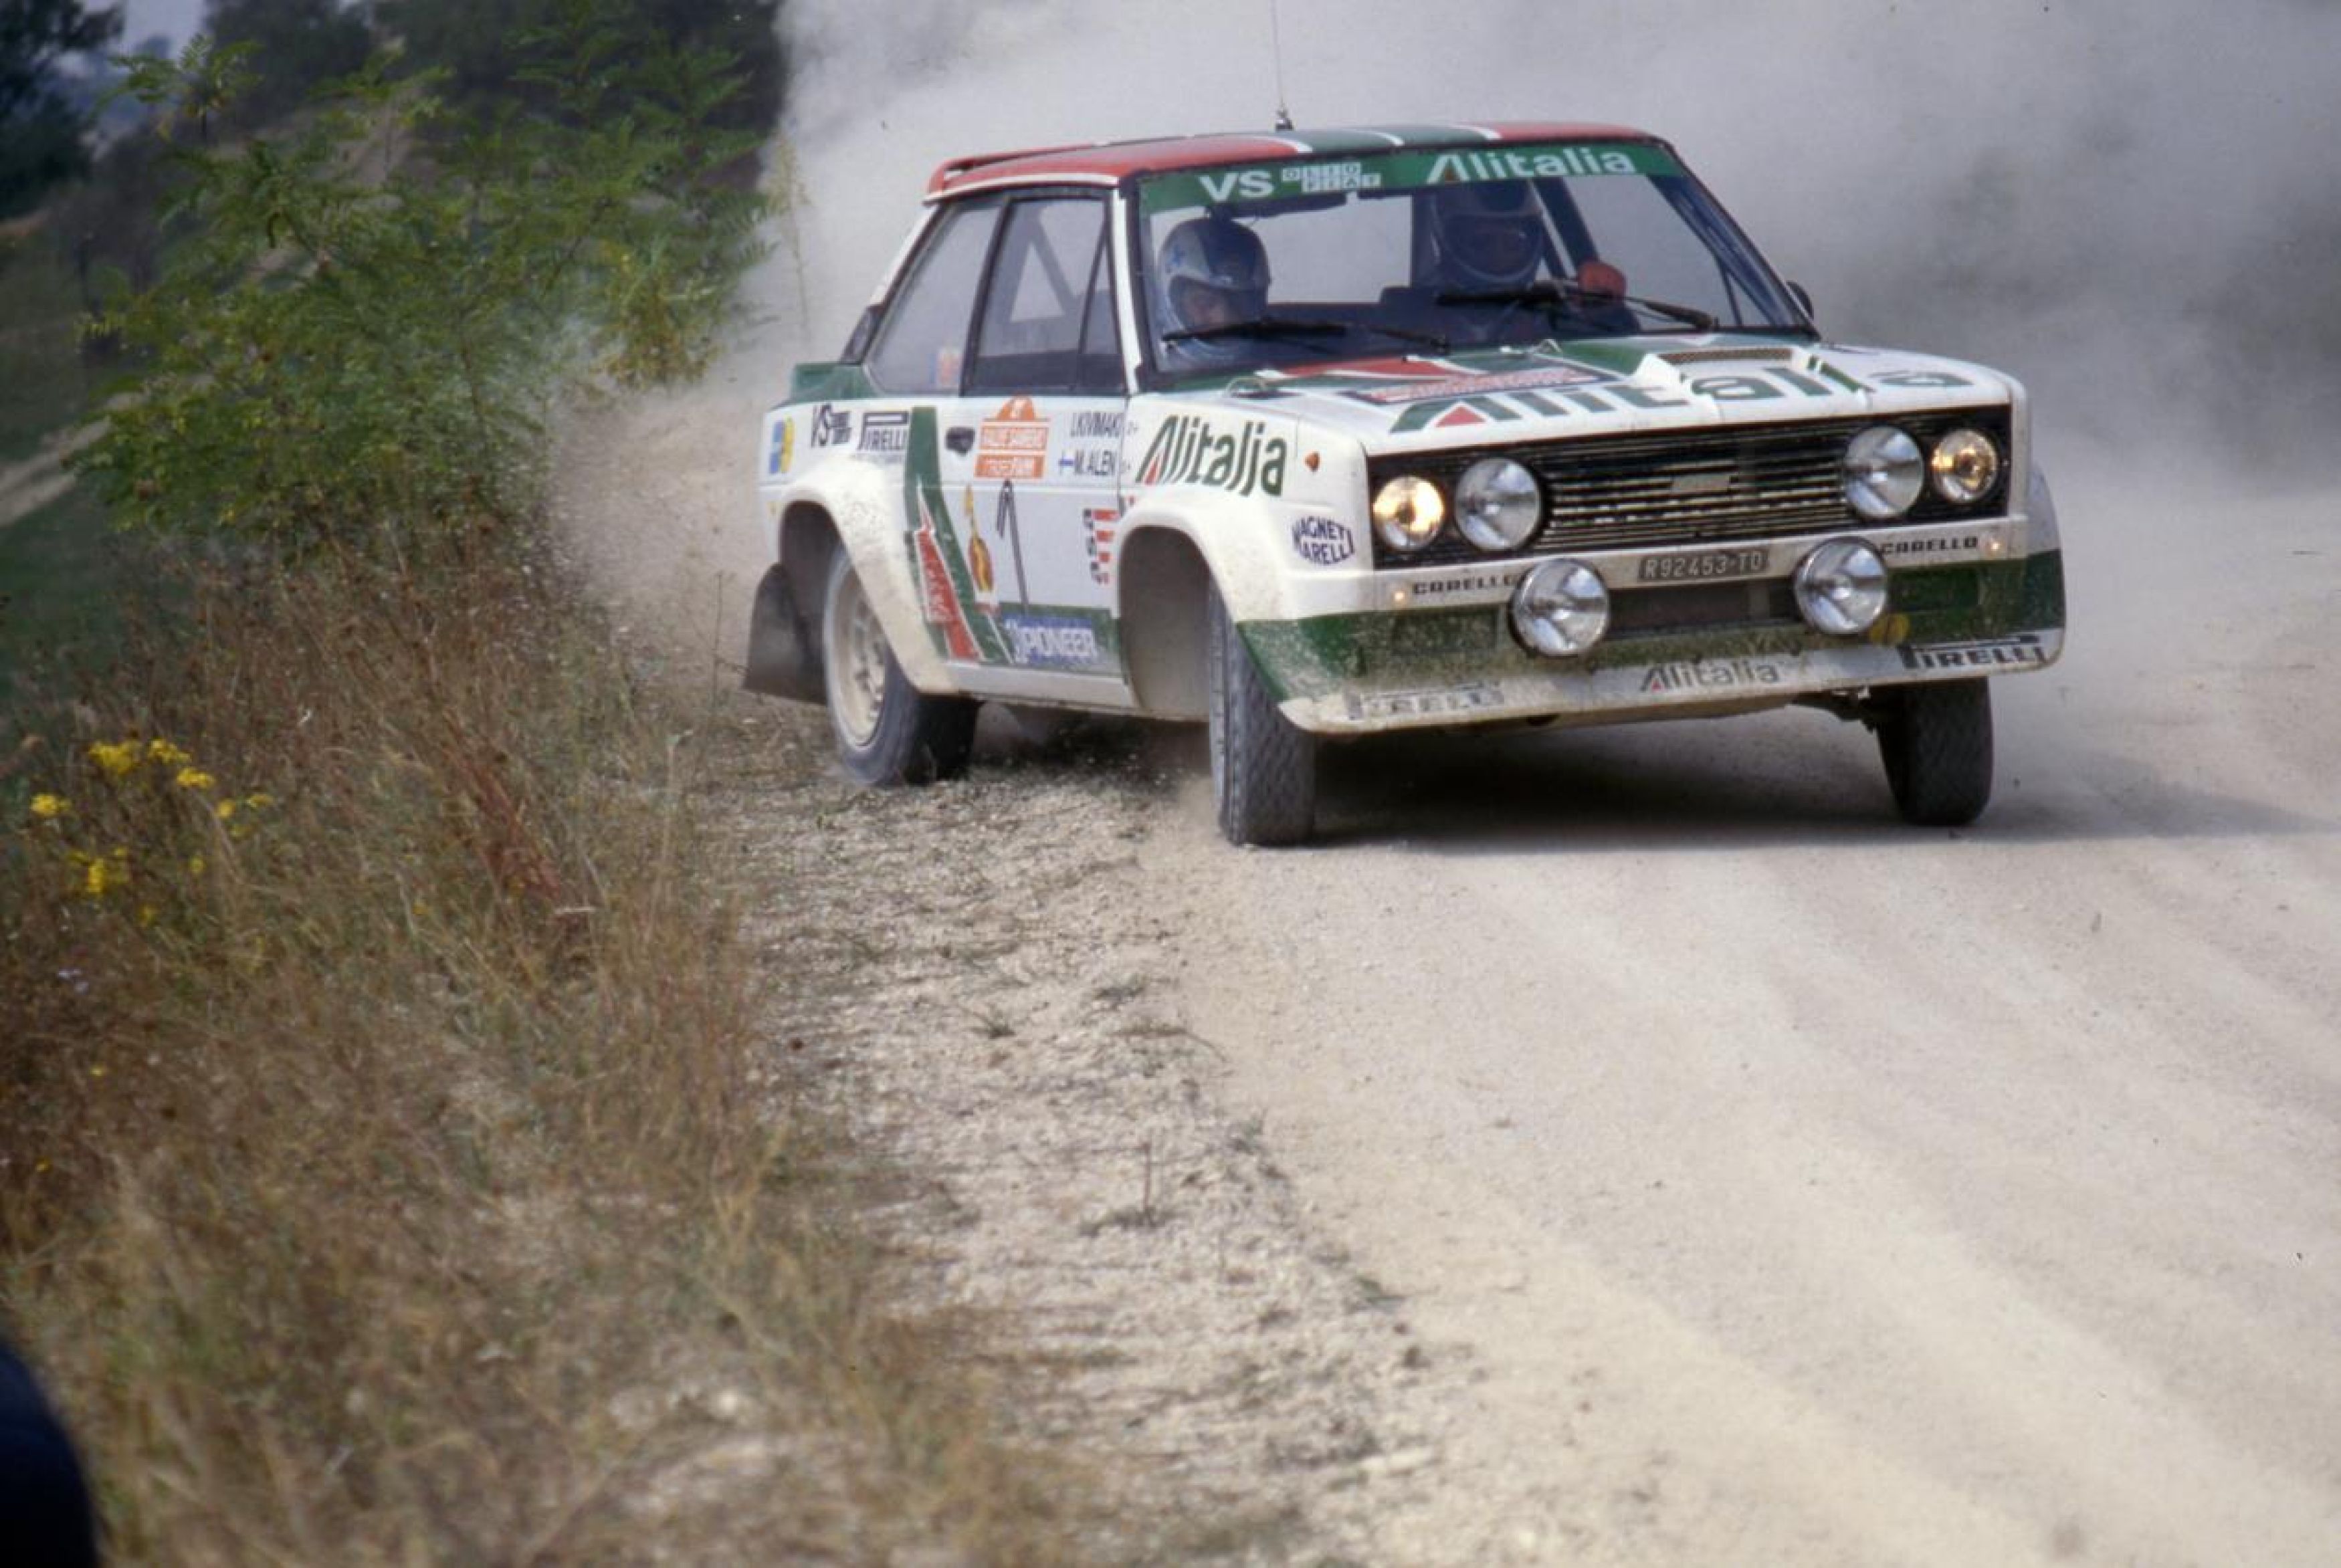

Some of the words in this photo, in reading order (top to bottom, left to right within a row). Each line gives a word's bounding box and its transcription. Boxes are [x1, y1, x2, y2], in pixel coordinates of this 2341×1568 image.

[1426, 147, 1636, 185] Alitalia
[1195, 170, 1274, 202] VS
[1136, 415, 1288, 497] Alitalia
[1881, 536, 1978, 555] CARELLO
[1640, 658, 1780, 692] Alitalia
